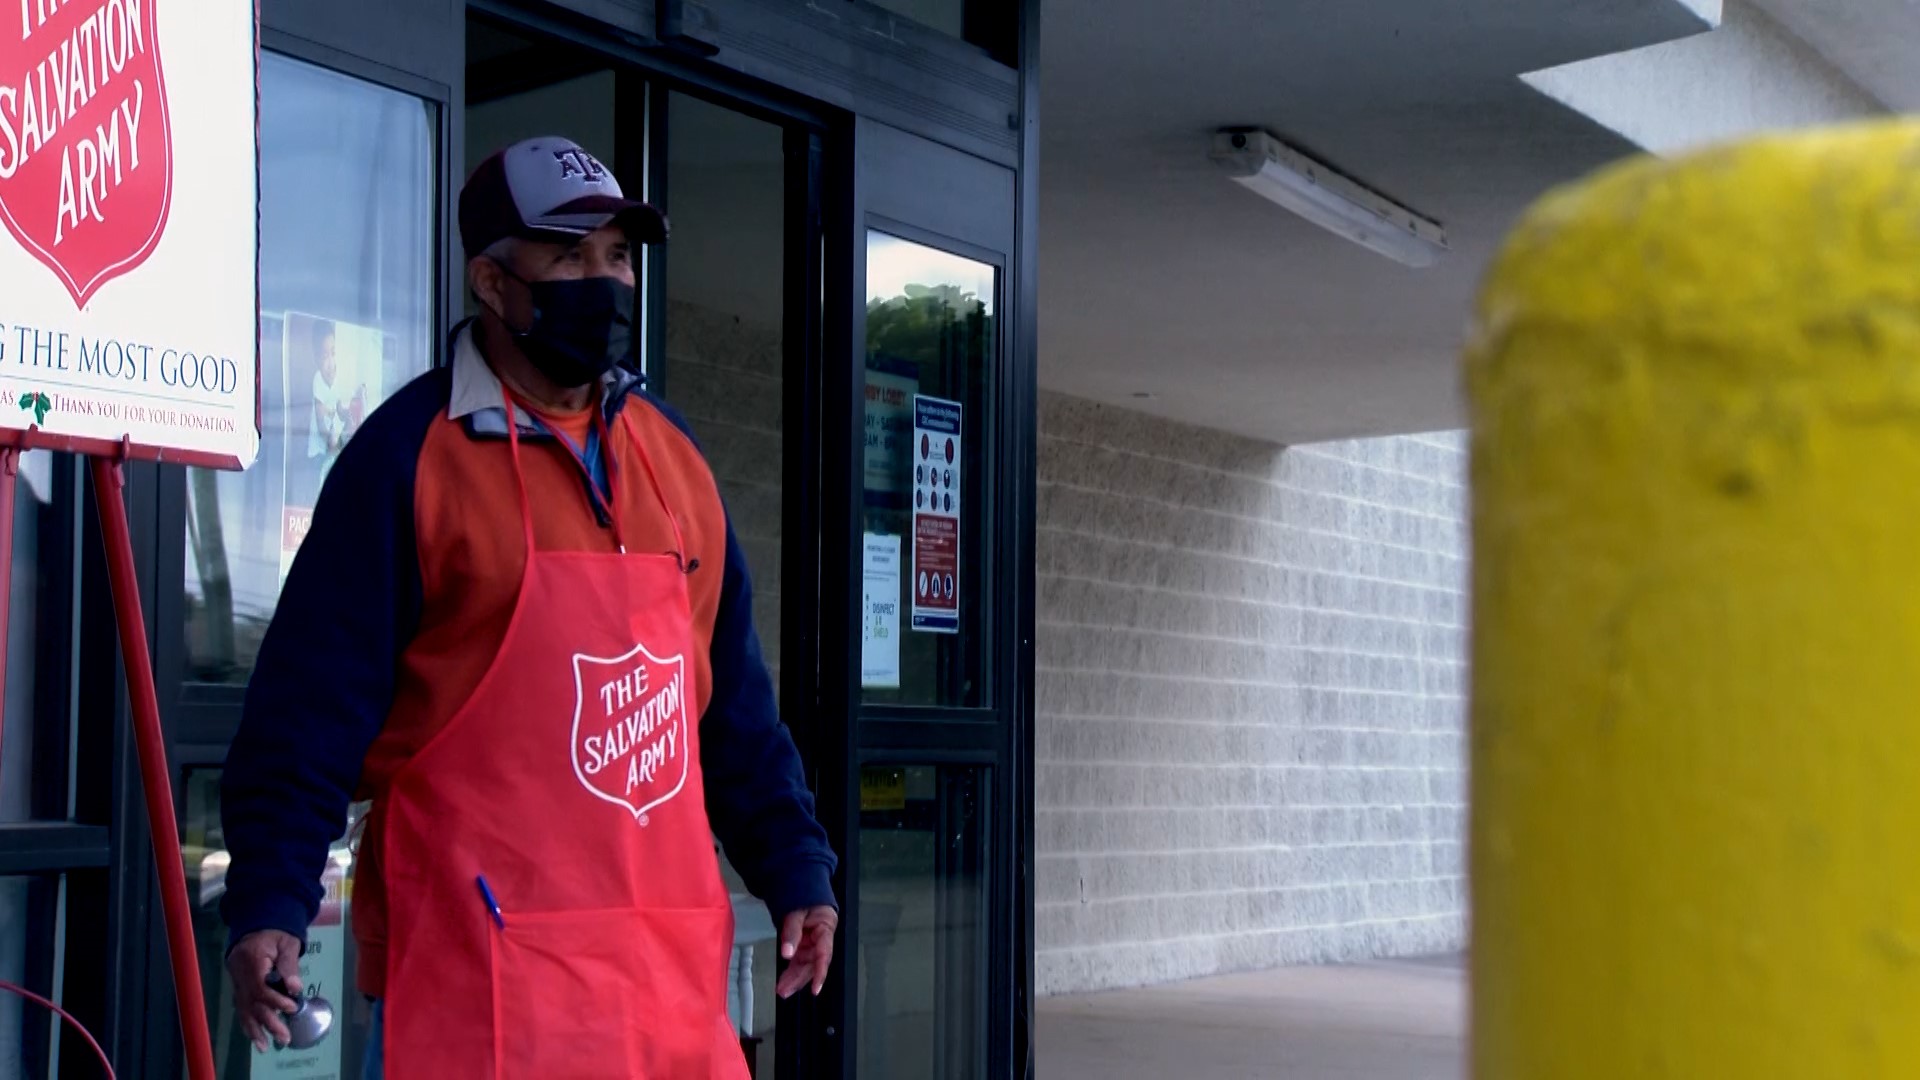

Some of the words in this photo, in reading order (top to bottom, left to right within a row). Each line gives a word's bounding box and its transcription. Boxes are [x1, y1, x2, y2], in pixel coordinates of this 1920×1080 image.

[0, 0, 144, 179] SALVATION
[54, 79, 143, 247] ARMY
[14, 325, 70, 371] THE
[78, 336, 153, 382] MOST
[160, 349, 237, 394] GOOD
[53, 393, 94, 416] THANK
[97, 402, 120, 419] YOU
[124, 406, 146, 423] FOR
[149, 409, 177, 426] YOUR
[179, 412, 237, 434] DONATION.
[584, 671, 680, 775] SALVATION
[600, 664, 649, 717] THE
[625, 719, 678, 796] ARMY
